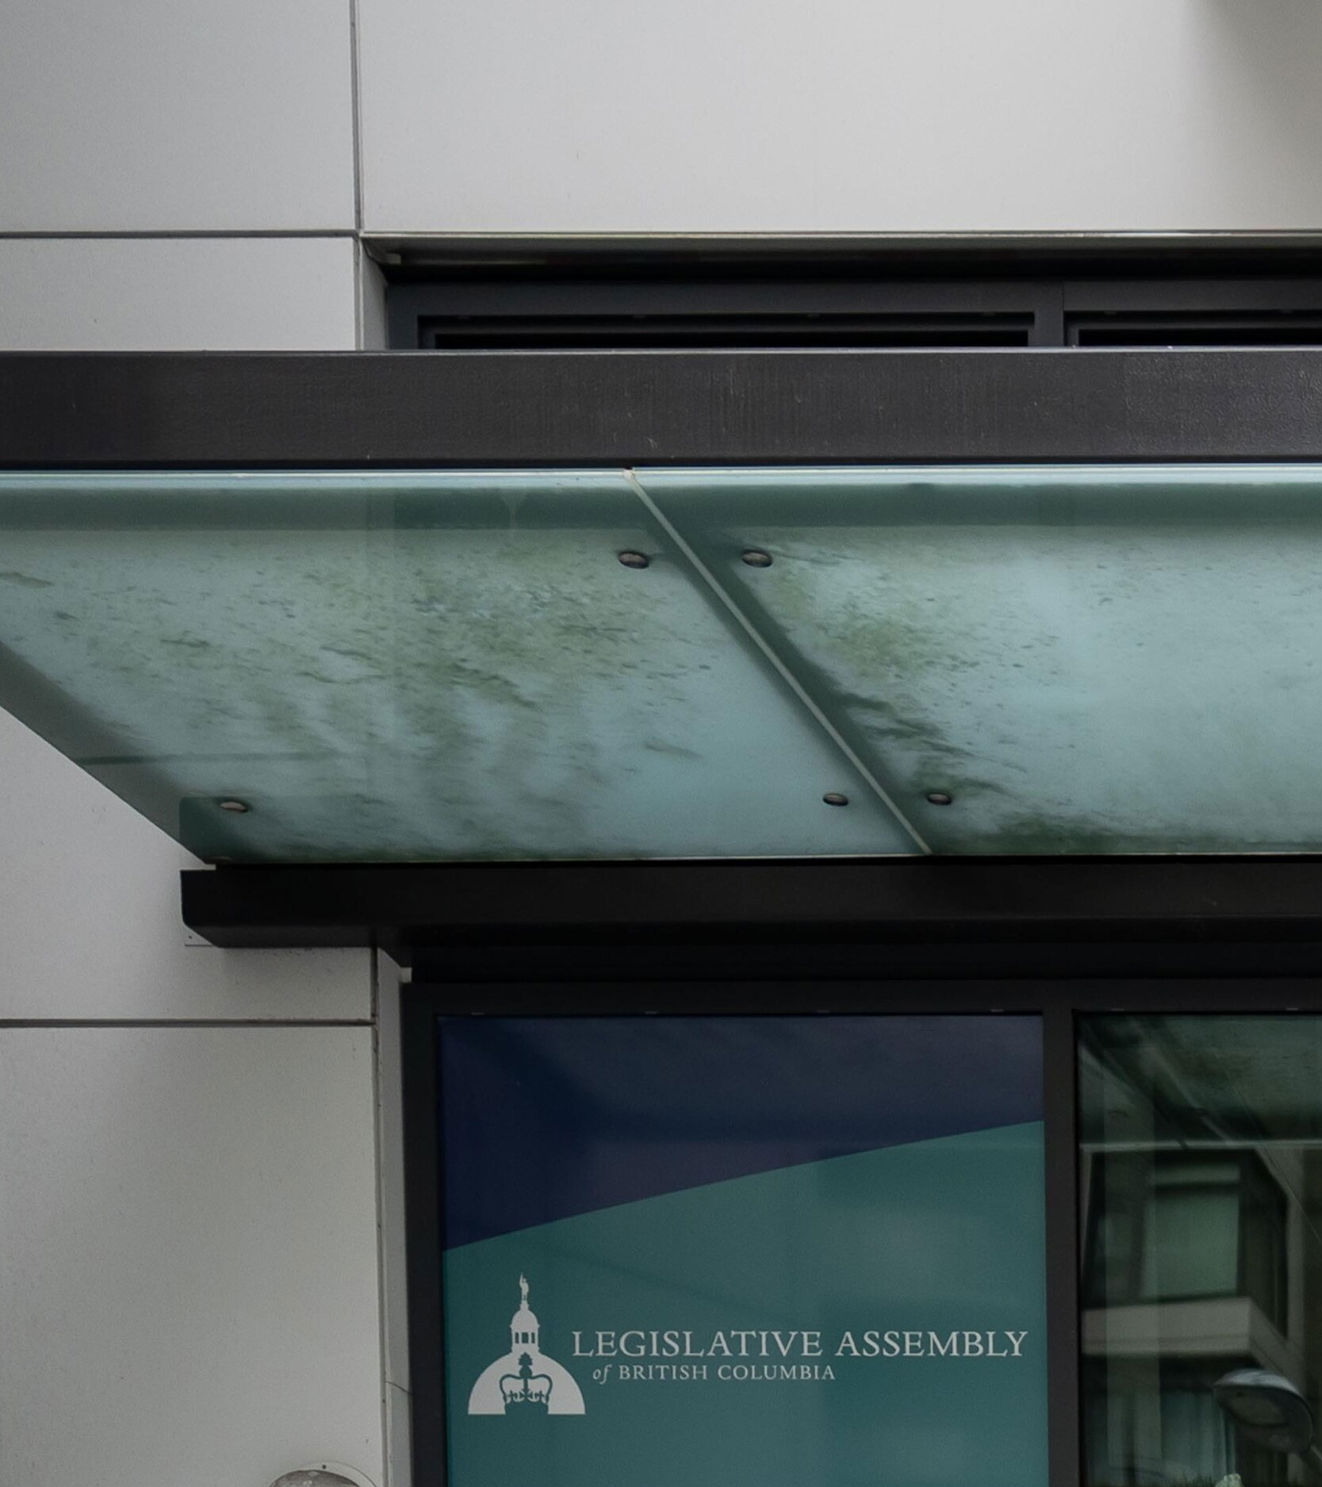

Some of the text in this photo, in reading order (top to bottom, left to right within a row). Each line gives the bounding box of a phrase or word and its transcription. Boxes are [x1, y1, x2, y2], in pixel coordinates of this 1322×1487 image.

[573, 1330, 1028, 1357] LEGISLATIVE ASSEMBLY
[593, 1364, 834, 1384] of BRITISH COLUMBIA
